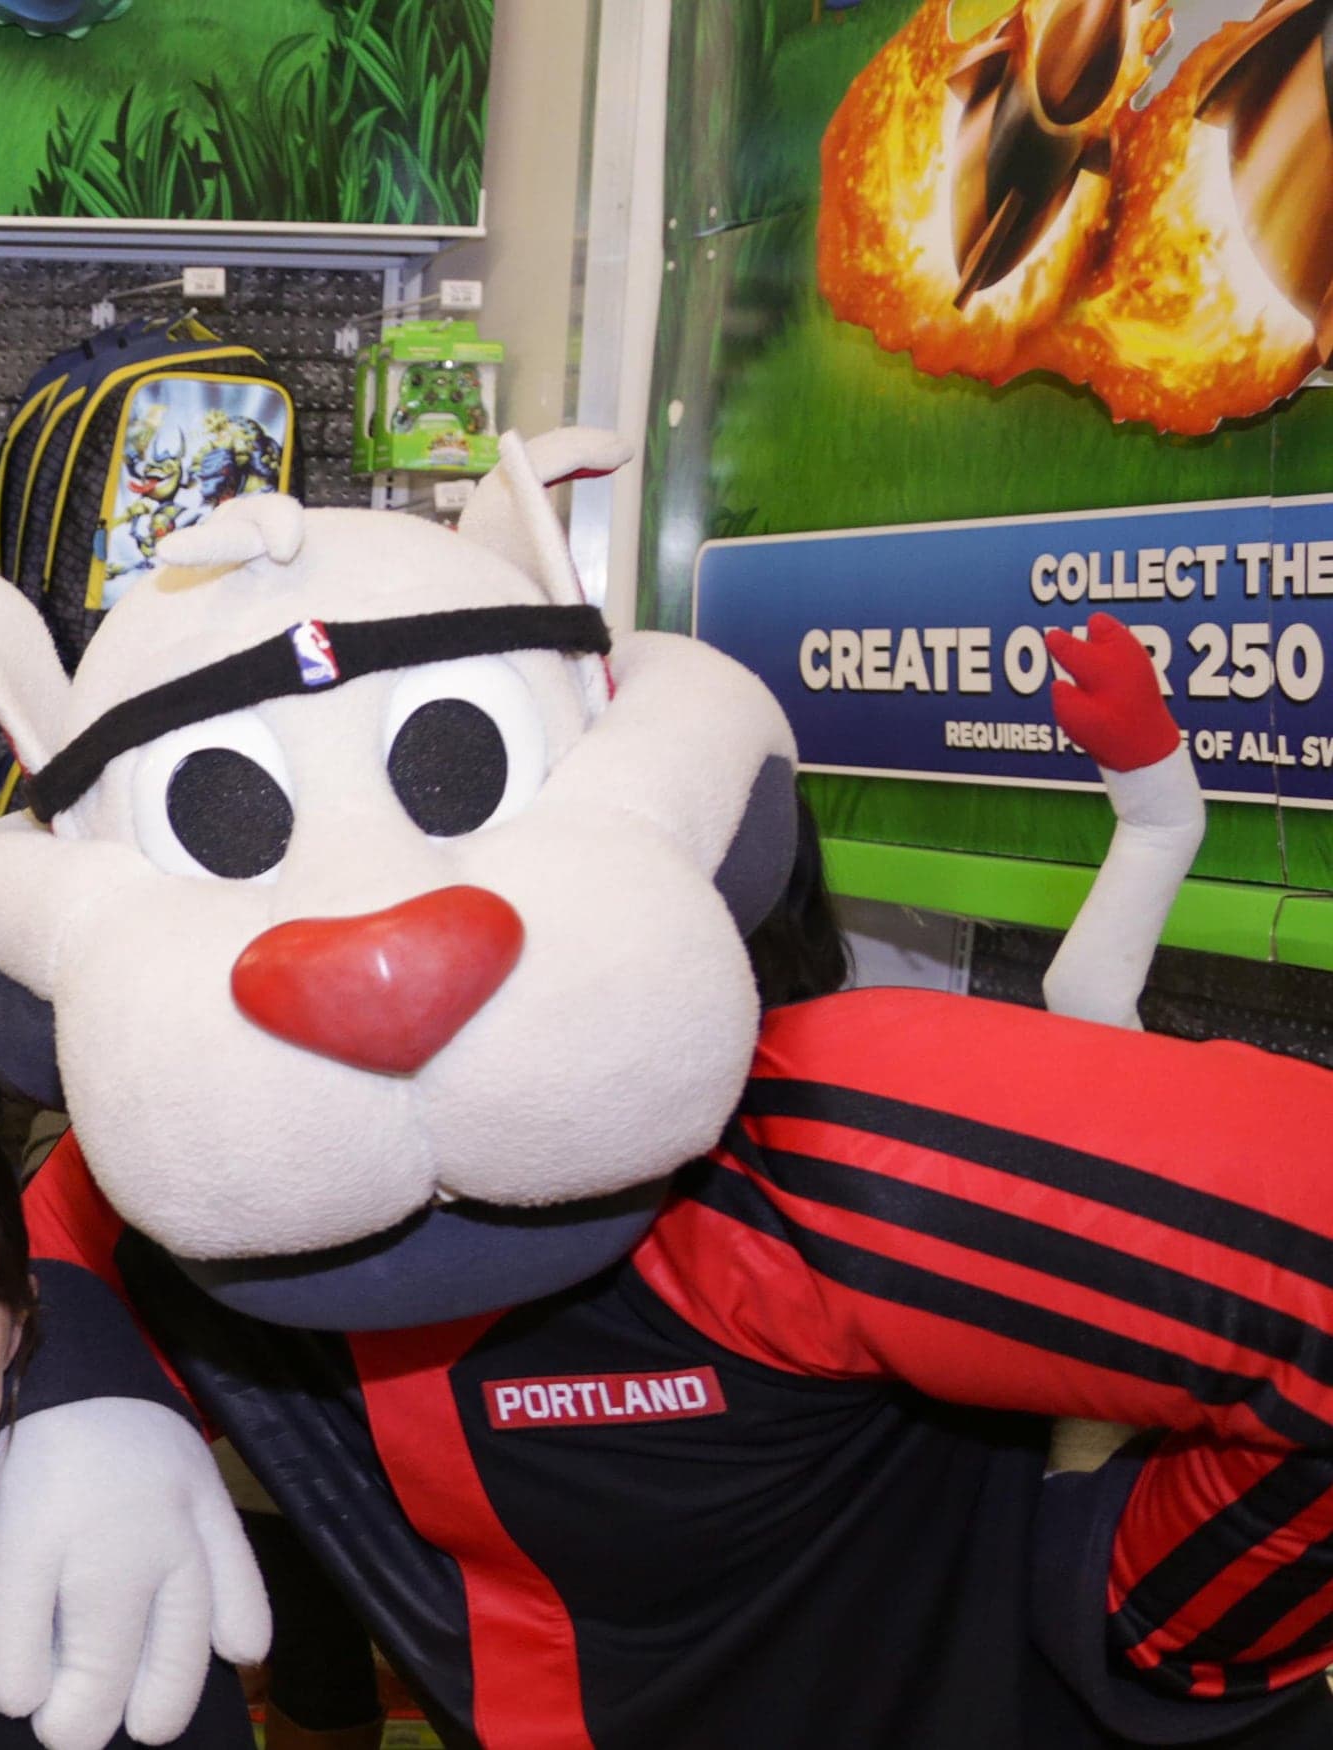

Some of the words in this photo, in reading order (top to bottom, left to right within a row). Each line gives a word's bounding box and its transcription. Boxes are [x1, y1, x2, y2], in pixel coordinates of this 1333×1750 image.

[1031, 545, 1227, 602] COLLECT
[1237, 541, 1333, 595] THE
[799, 627, 992, 693] CREATE
[1188, 623, 1324, 701] 250
[945, 720, 1052, 752] REQUIRES
[1195, 729, 1232, 760] OF
[1238, 731, 1296, 766] ALL
[495, 1375, 707, 1421] PORTLAND
